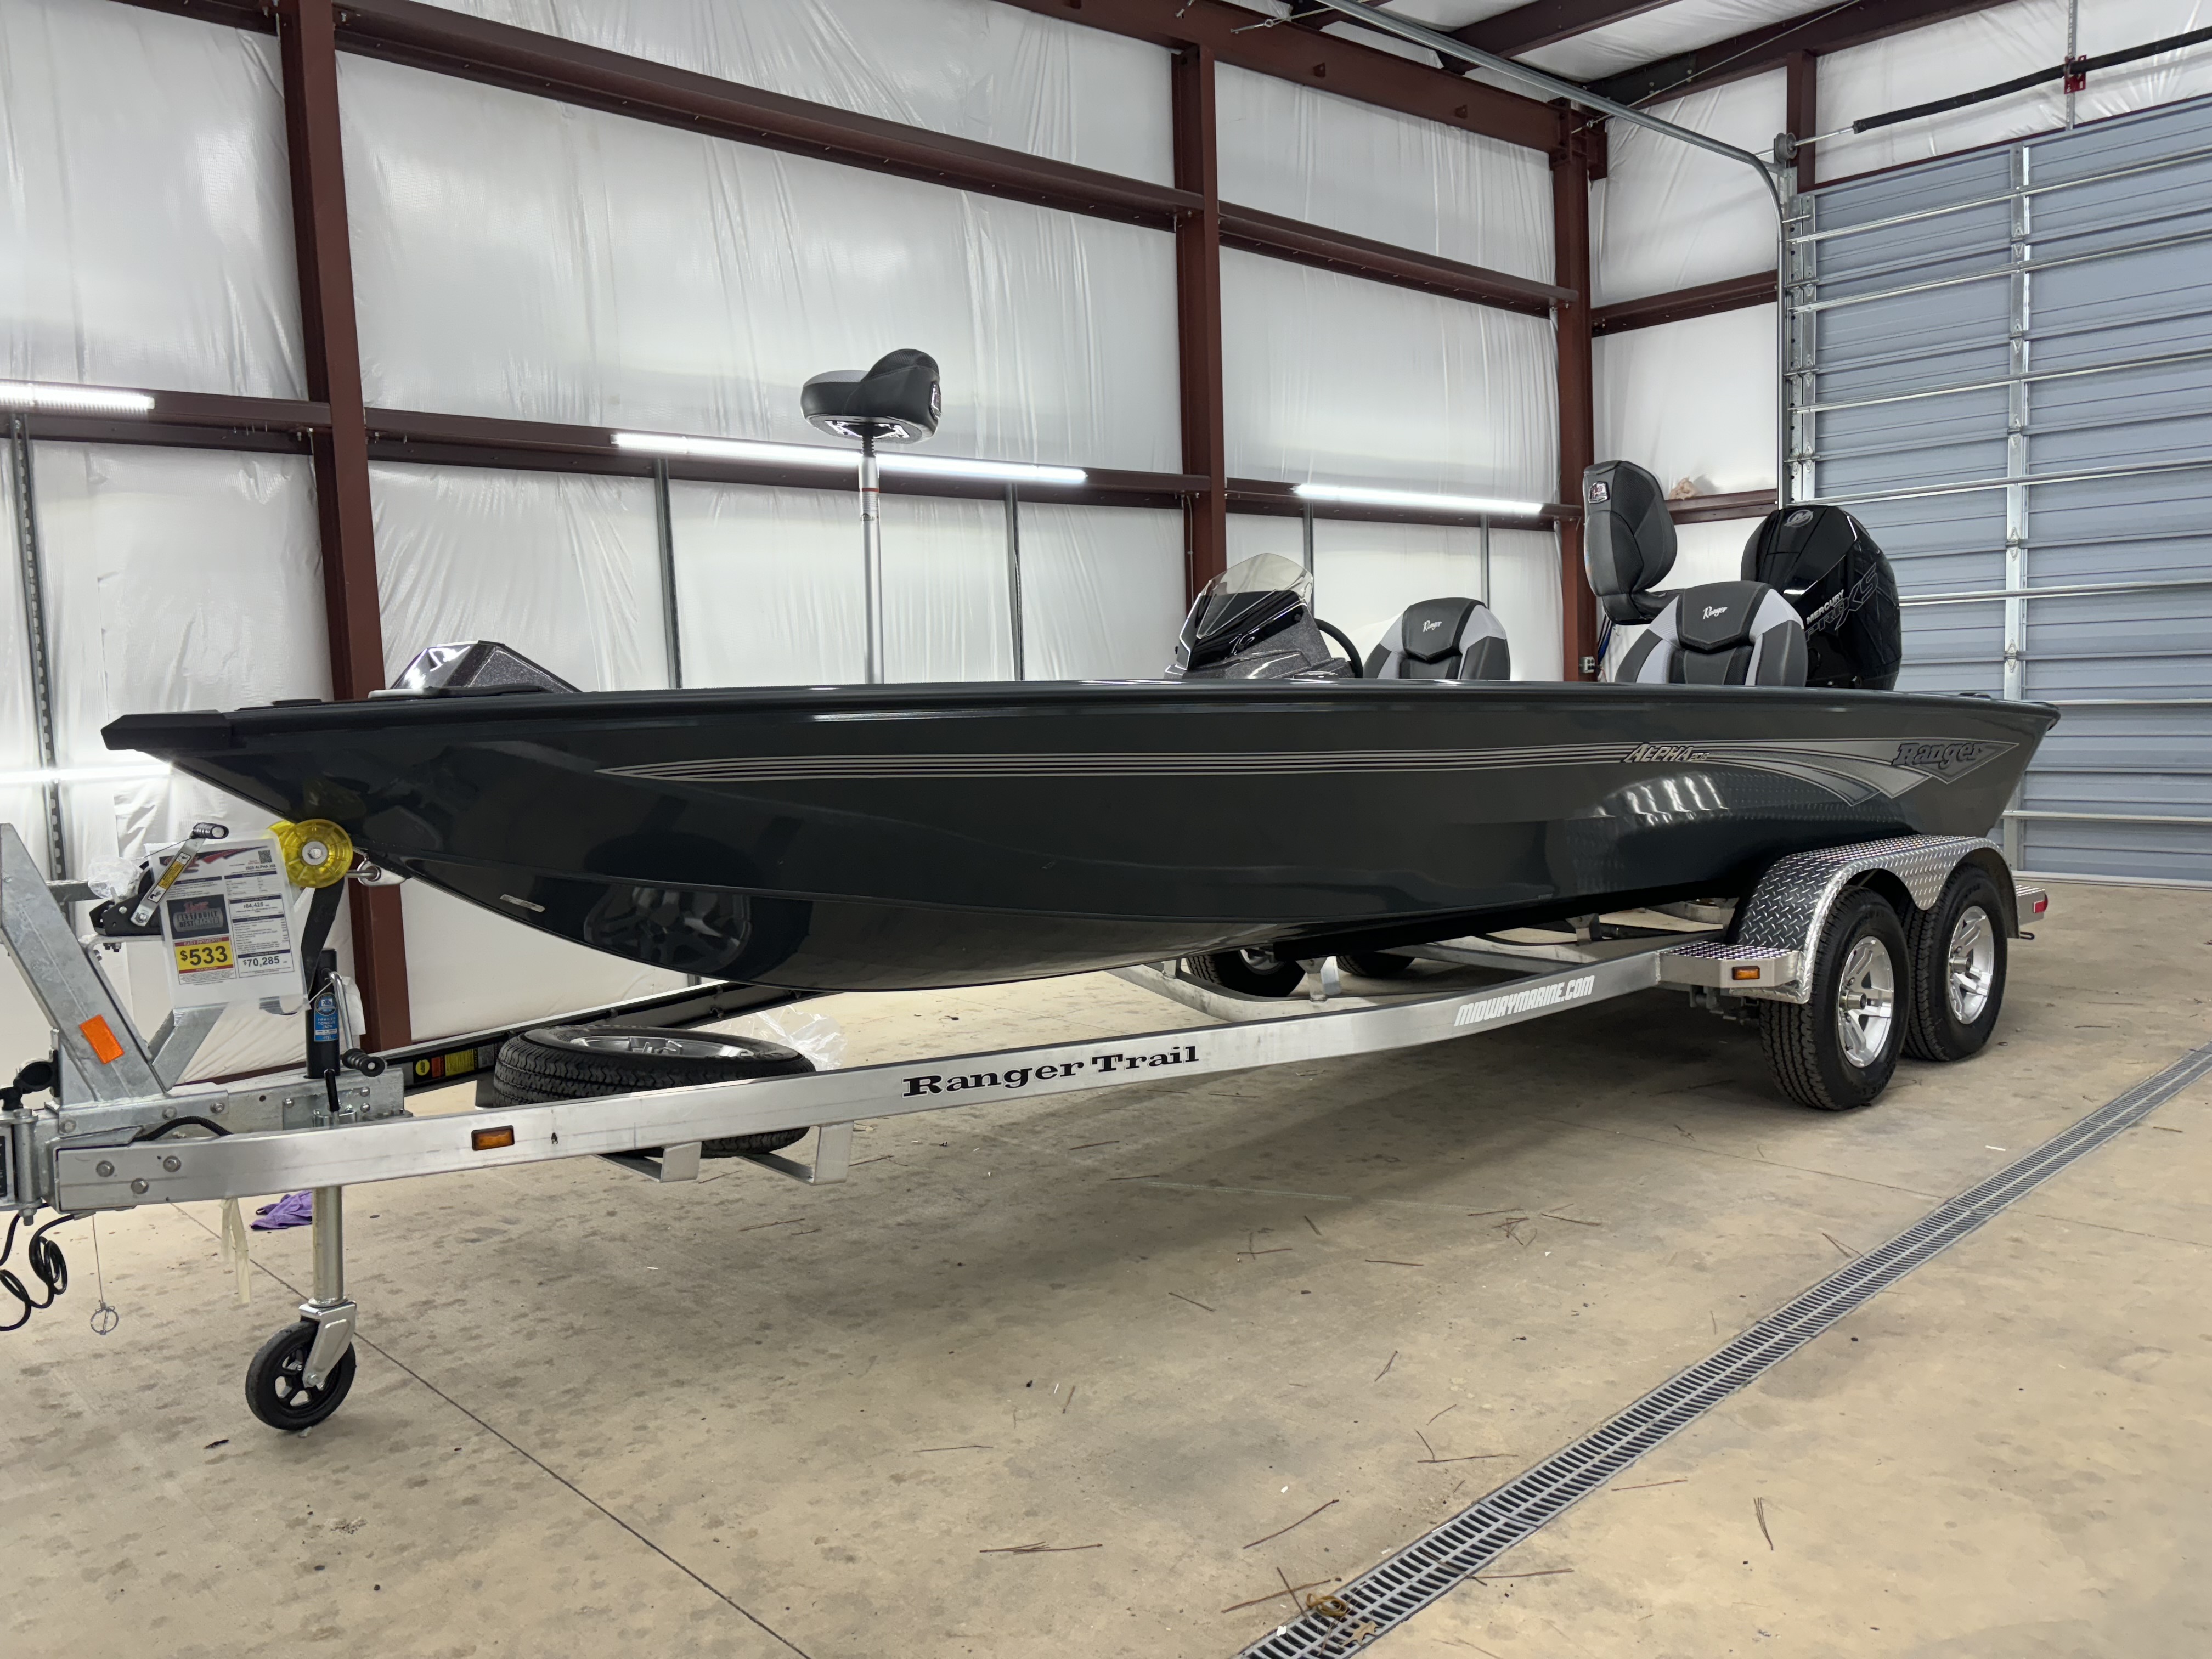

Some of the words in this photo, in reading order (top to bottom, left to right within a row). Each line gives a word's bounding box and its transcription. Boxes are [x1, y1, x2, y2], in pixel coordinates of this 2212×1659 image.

[1702, 606, 1728, 619] Ranger
[1806, 589, 1844, 625] MERCURY
[1423, 620, 1442, 632] Ranger
[1622, 742, 1694, 763] ALPHA
[1891, 742, 1985, 770] Ranger
[180, 945, 228, 966] $533
[242, 956, 280, 967] $70,285
[1454, 975, 1595, 1026] MIDWAYMARINE.COM
[902, 1062, 1085, 1097] Ranger
[1091, 1046, 1199, 1073] Trail
